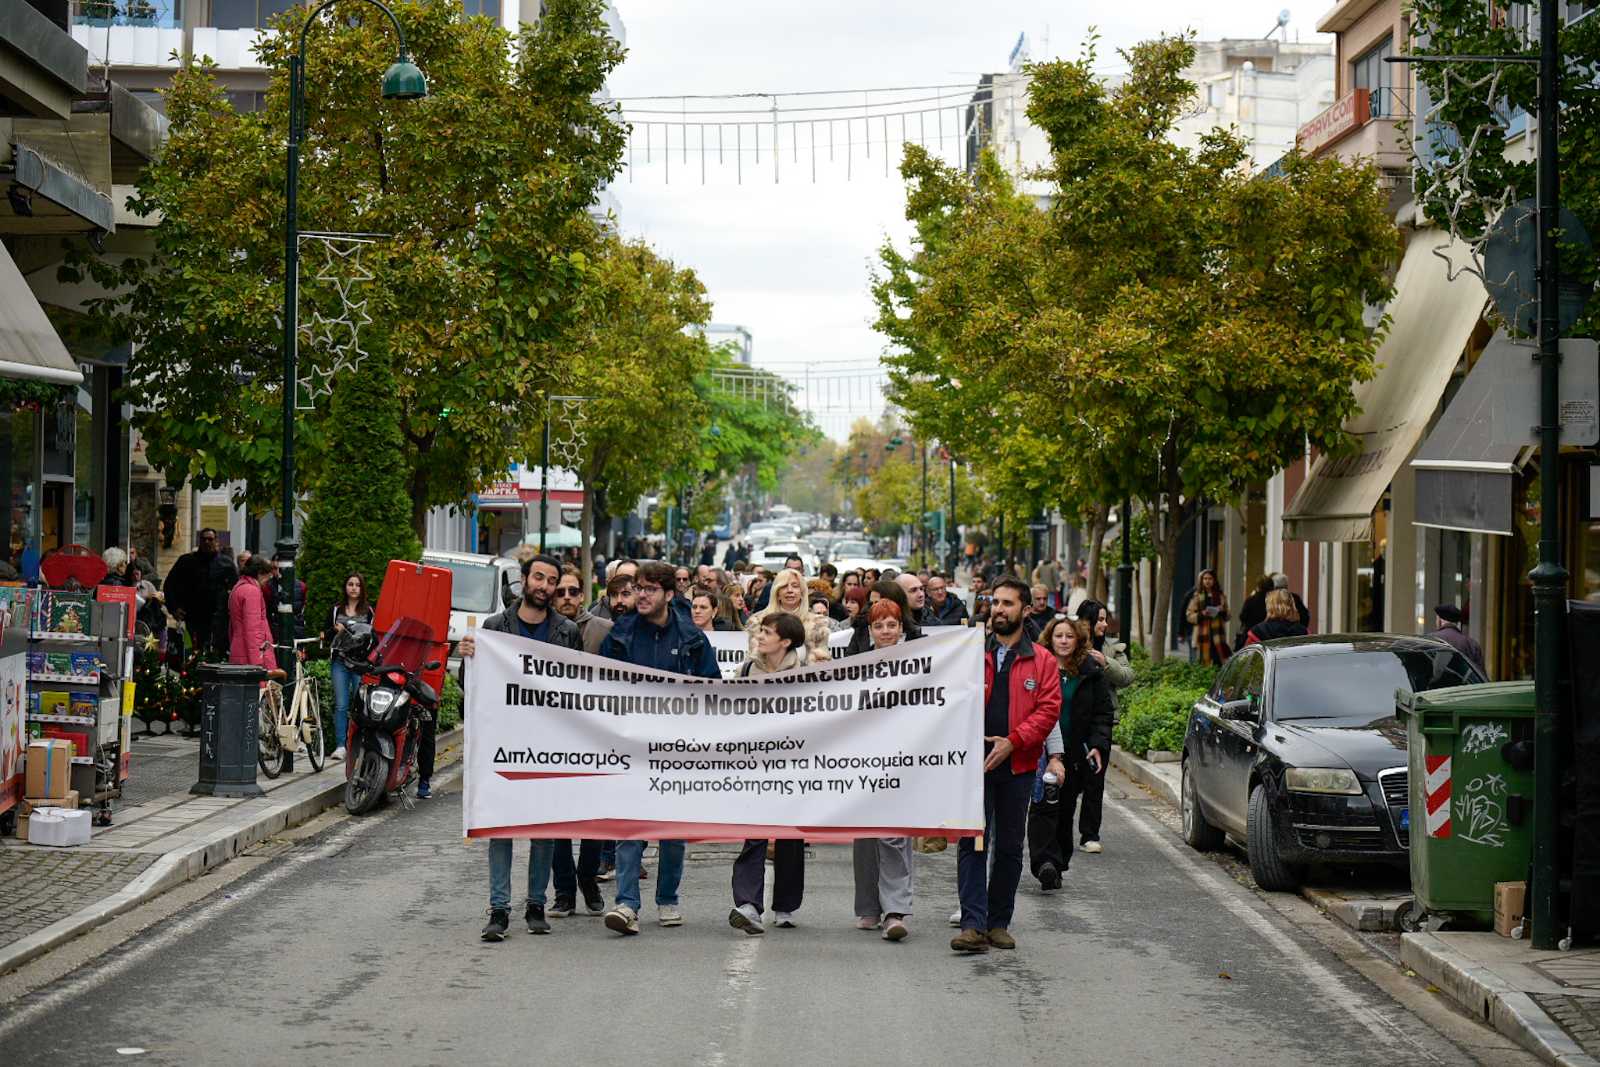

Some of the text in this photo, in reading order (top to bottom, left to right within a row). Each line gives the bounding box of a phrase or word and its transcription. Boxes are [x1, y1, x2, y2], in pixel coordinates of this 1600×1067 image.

[518, 653, 593, 683] Ένωση
[505, 683, 946, 716] Πανεπιστημιακού Νοσοκομείου Λάρισας
[648, 735, 805, 755] μισθών εφημεριών
[493, 747, 631, 769] Διπλασιασμός
[648, 750, 968, 773] προσωπικού για τα Νοσοκομεία και ΚΥ
[649, 773, 900, 796] Χρηματοδότησης για την Υγεία
